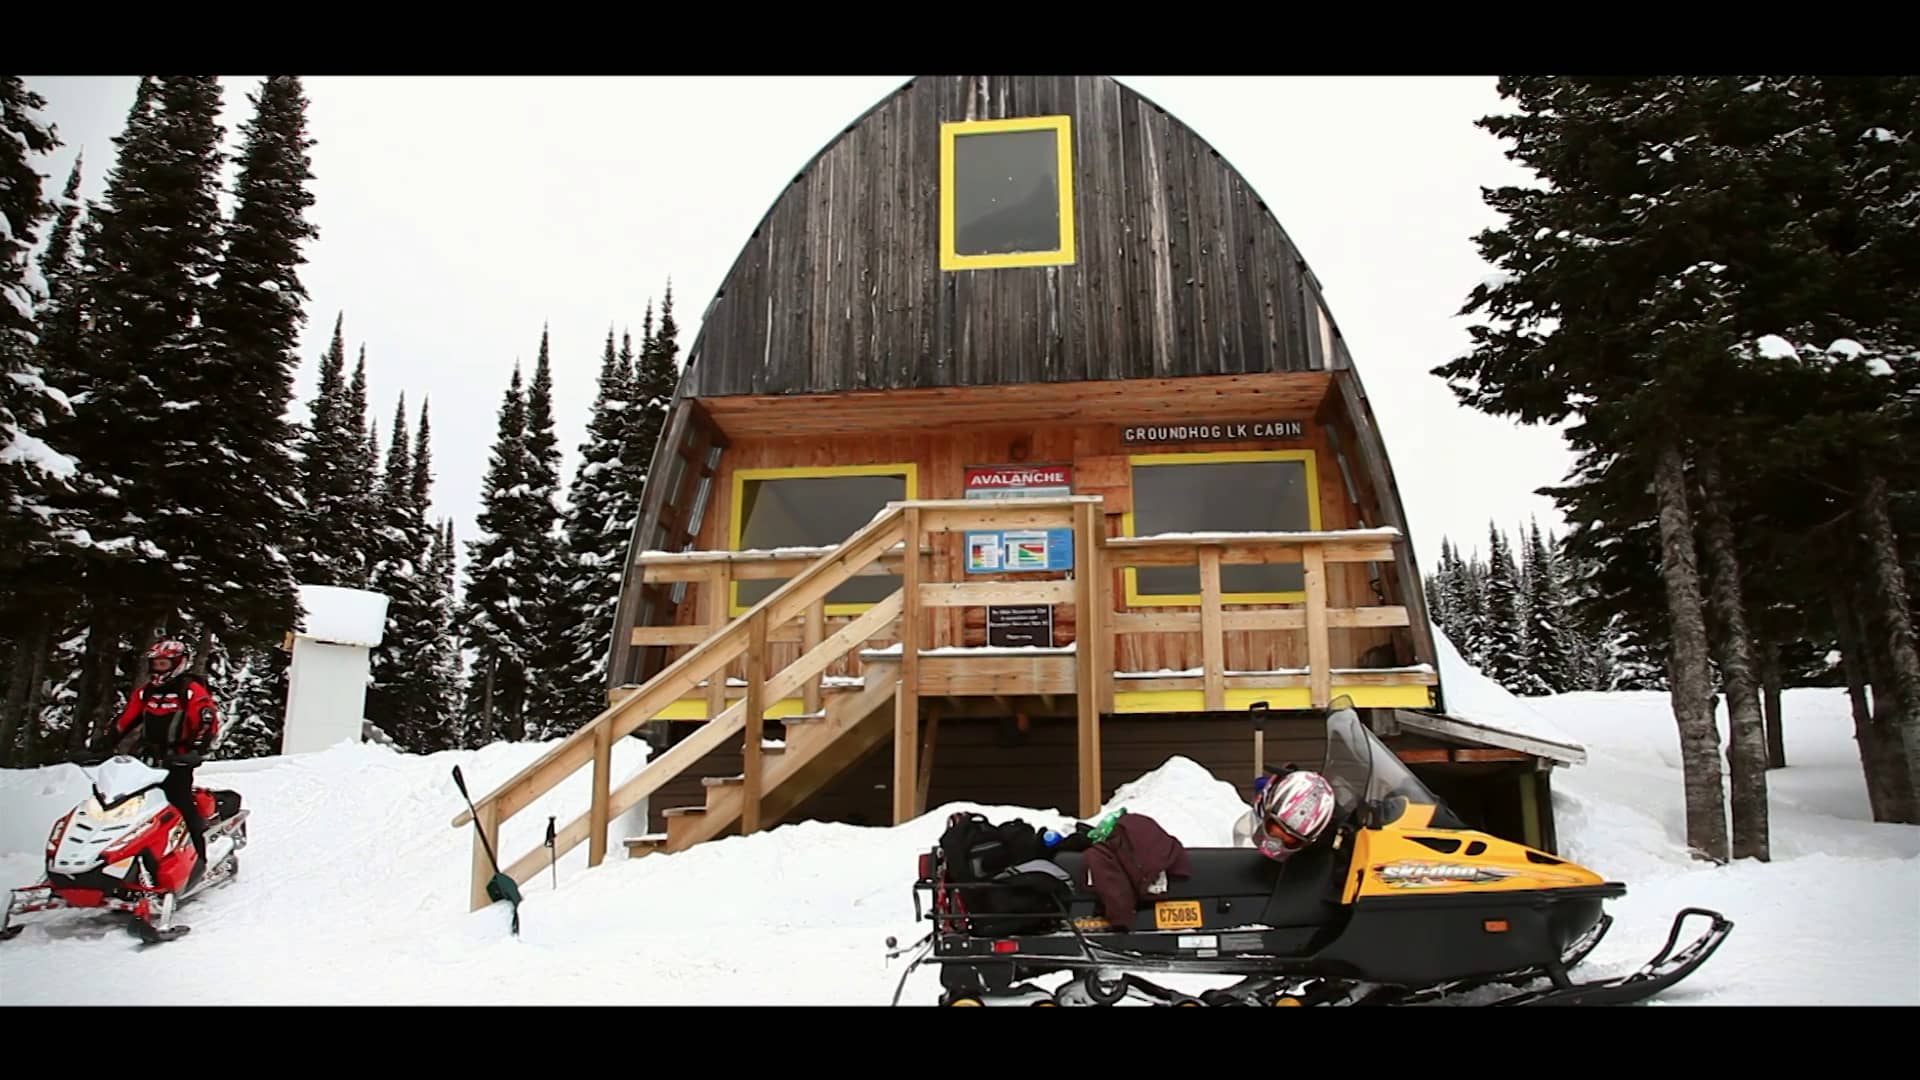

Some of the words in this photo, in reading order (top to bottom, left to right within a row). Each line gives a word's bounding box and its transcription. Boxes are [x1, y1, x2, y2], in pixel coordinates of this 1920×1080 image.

[1125, 426, 1221, 441] GROUNDHOG
[1227, 424, 1247, 438] LK
[1254, 422, 1302, 437] CABIN
[971, 472, 1065, 486] AVALANCHE
[1159, 907, 1199, 922] C75085
